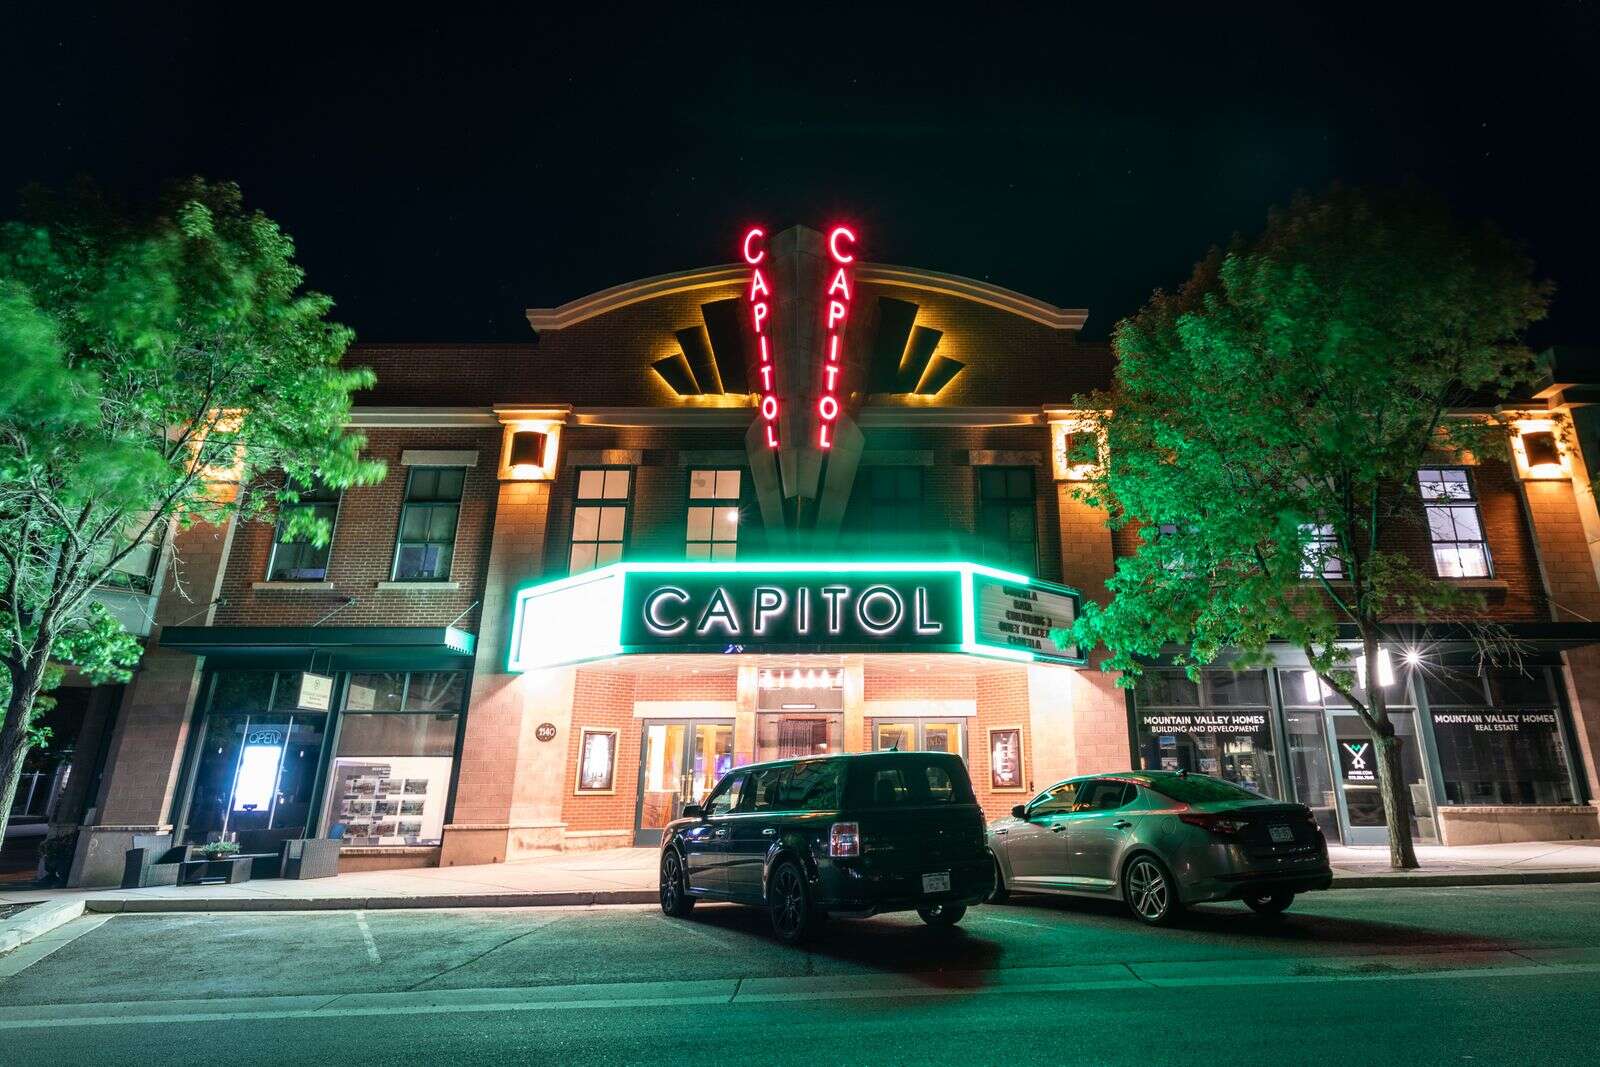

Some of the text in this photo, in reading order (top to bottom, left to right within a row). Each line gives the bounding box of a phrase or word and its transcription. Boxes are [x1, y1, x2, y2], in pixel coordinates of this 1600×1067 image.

[743, 228, 779, 448] CAPITOL
[819, 226, 856, 448] CAPITOL
[643, 585, 942, 635] CAPITOL
[1143, 715, 1265, 725] MOUNTAIN VALLEY HOMES
[1434, 714, 1555, 723] MOUNTAIN VALLEY HOMES
[1151, 725, 1259, 733] BUILDING AND DEVELOPMENT
[249, 732, 280, 744] OPEN
